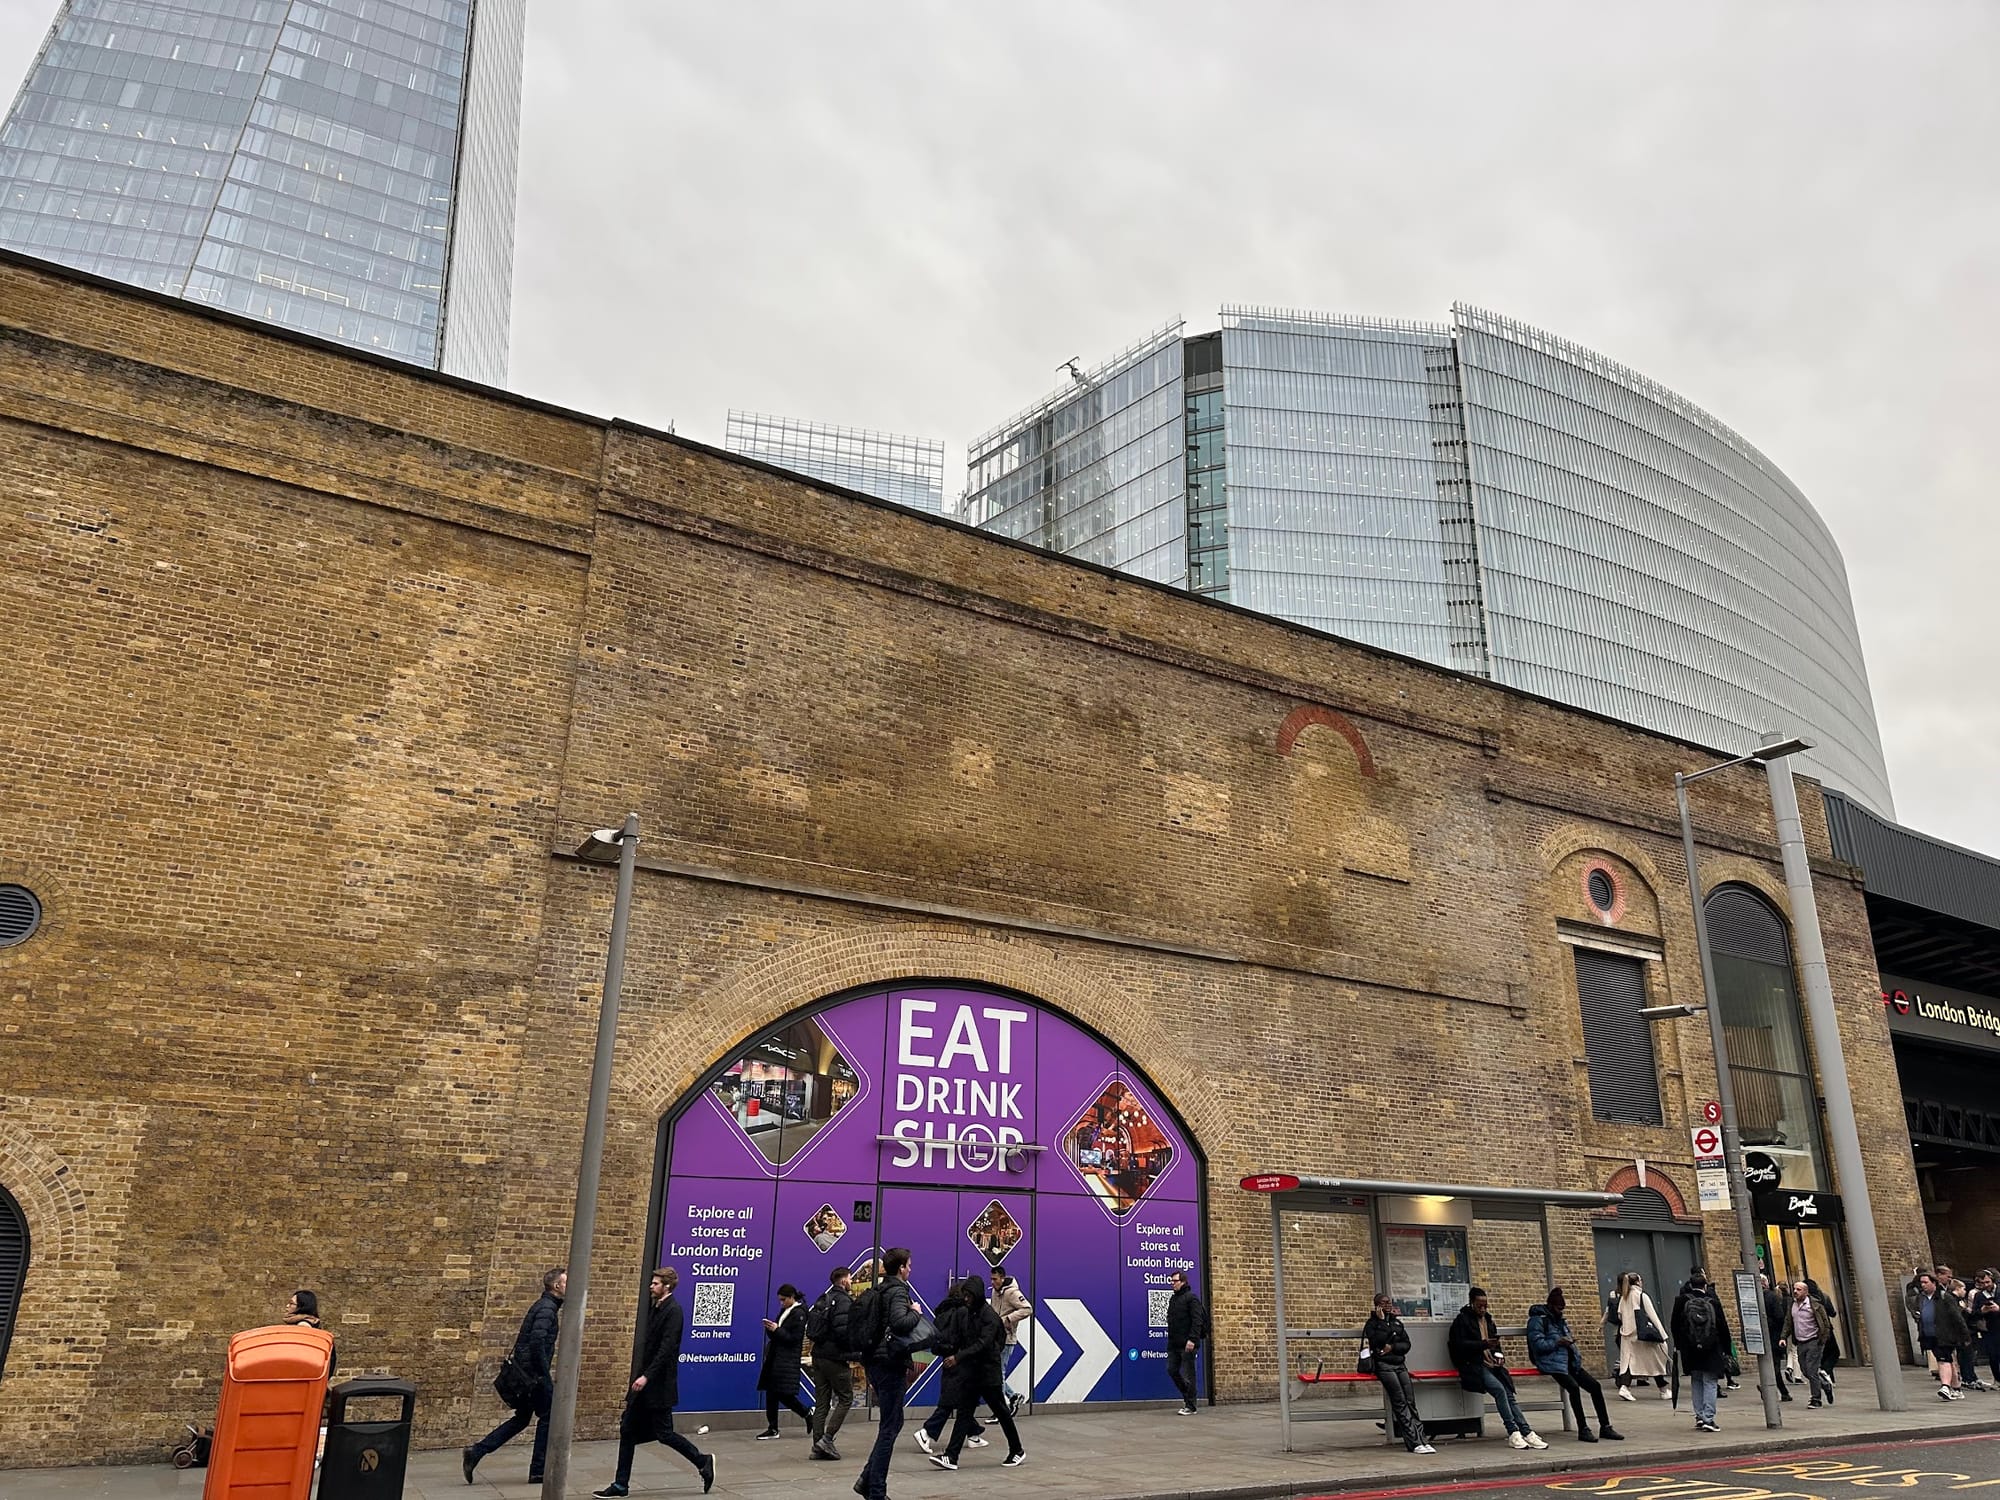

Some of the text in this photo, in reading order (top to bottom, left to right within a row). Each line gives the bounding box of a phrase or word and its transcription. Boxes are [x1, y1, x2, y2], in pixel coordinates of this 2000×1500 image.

[1916, 995, 2000, 1036] London Bridg
[899, 999, 1028, 1074] EAT
[896, 1074, 1023, 1119] DRINK
[1708, 1105, 1717, 1118] S
[892, 1119, 1024, 1172] SHOP
[1744, 1164, 1775, 1183] Bagel
[688, 1205, 753, 1221] Explore all
[855, 1204, 871, 1219] 48
[1788, 1195, 1816, 1217] Bagel
[691, 1226, 746, 1238] stores at
[1136, 1223, 1184, 1237] Explore all
[671, 1243, 763, 1260] London Bridge
[1140, 1241, 1181, 1252] stores at
[691, 1263, 739, 1276] Station
[1127, 1256, 1194, 1271] London Bridge
[1144, 1273, 1173, 1284] Statio
[691, 1330, 731, 1339] Scan here
[1148, 1330, 1163, 1338] Scan
[678, 1353, 756, 1363] @NetworkRailLBG
[1730, 1461, 1970, 1487] BUS
